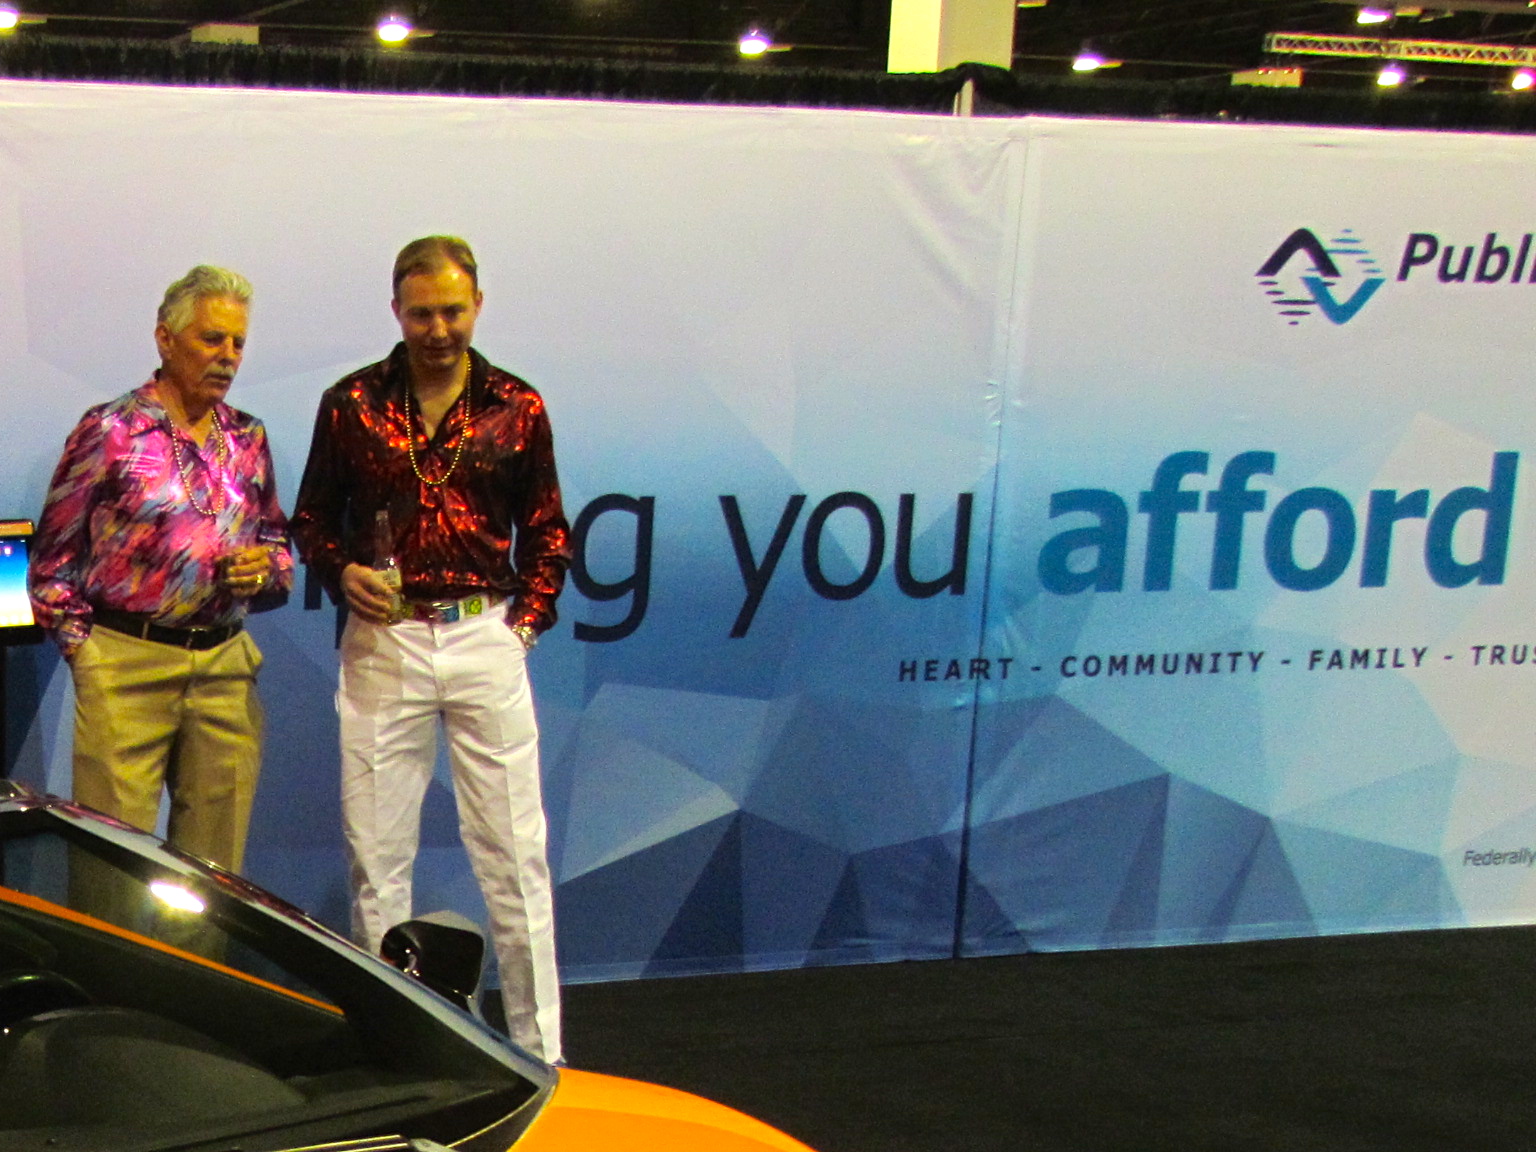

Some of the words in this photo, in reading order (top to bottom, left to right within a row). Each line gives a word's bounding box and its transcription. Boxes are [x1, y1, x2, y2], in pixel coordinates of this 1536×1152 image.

[719, 490, 974, 639] you
[1037, 450, 1520, 595] afford
[898, 658, 1013, 682] HEART
[1059, 651, 1265, 678] COMMUNITY
[1308, 647, 1428, 671] FAMILY
[1470, 644, 1536, 666] TRU
